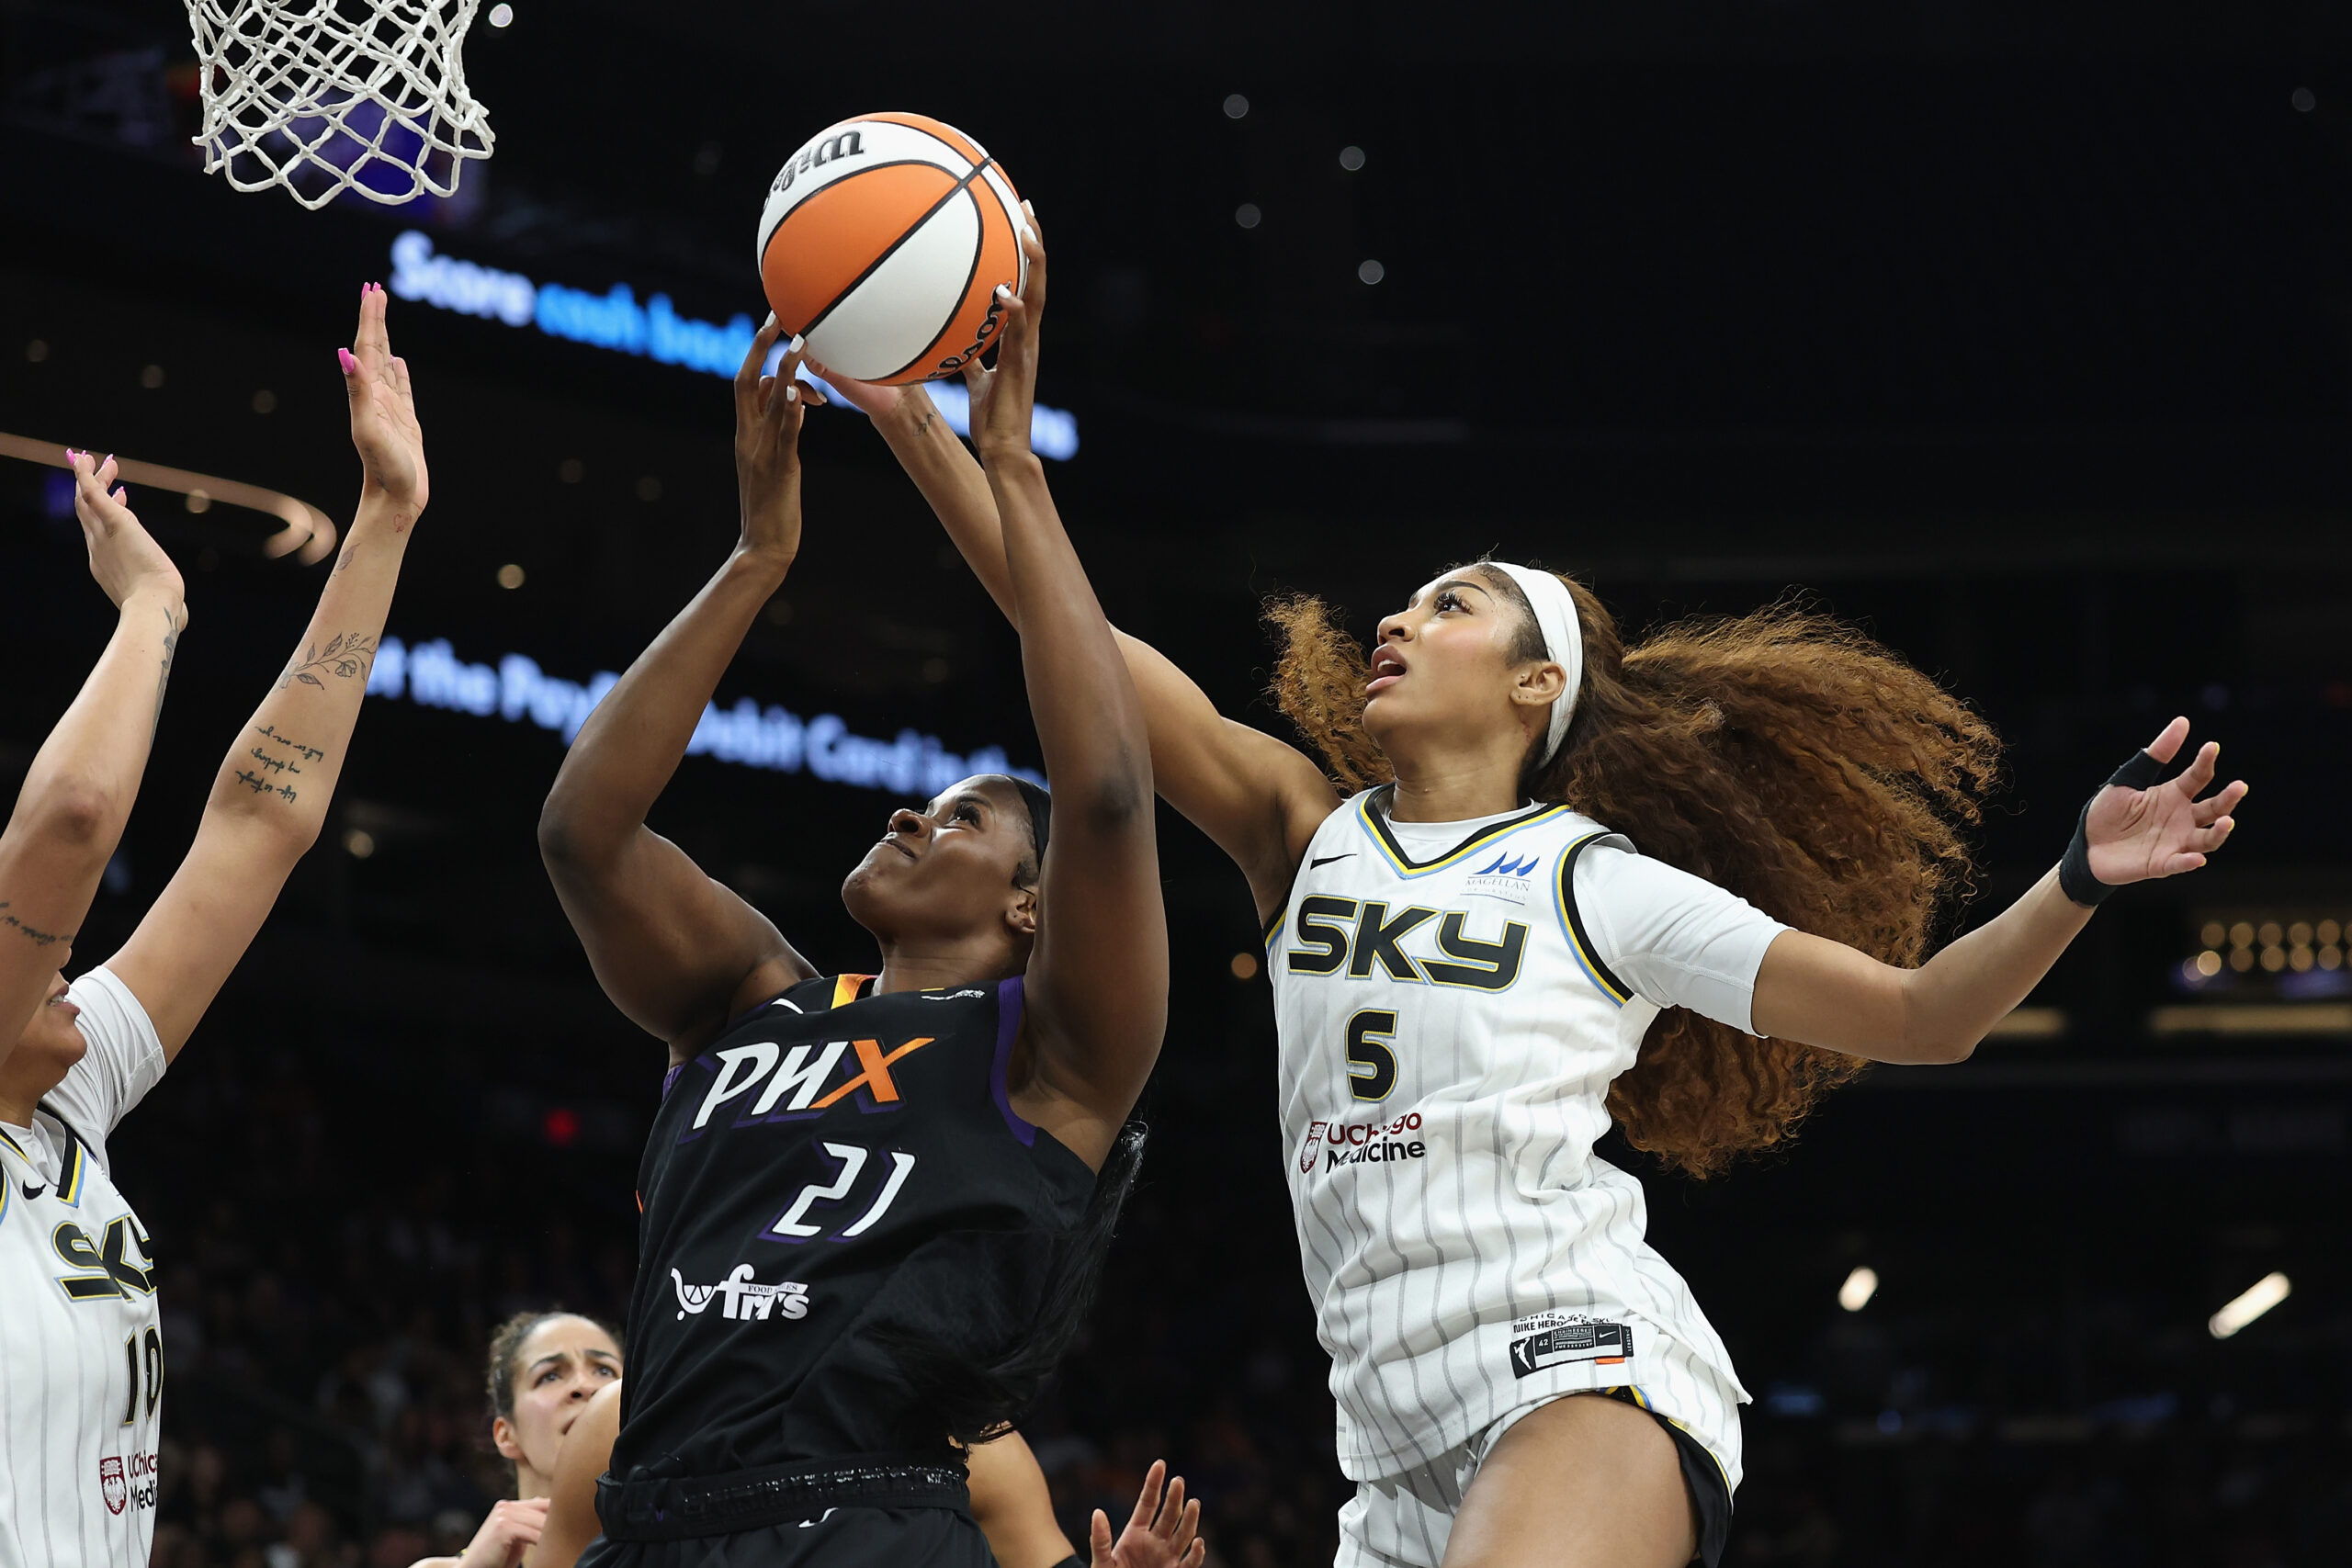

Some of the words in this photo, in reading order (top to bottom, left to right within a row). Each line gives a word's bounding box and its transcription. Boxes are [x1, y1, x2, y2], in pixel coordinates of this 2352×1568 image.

[763, 130, 865, 213] Wils
[905, 281, 1012, 381] ilson
[1464, 877, 1532, 892] MAGELLAN
[1287, 893, 1531, 995] SKY
[691, 1035, 937, 1131] PHX
[1344, 1007, 1399, 1104] 5
[1326, 1136, 1426, 1174] Mdicine
[1327, 1112, 1422, 1146] UChgo
[770, 1140, 918, 1239] 21
[1513, 1321, 1536, 1334] NIKE
[1538, 1337, 1549, 1347] 42
[121, 1325, 164, 1427] 10
